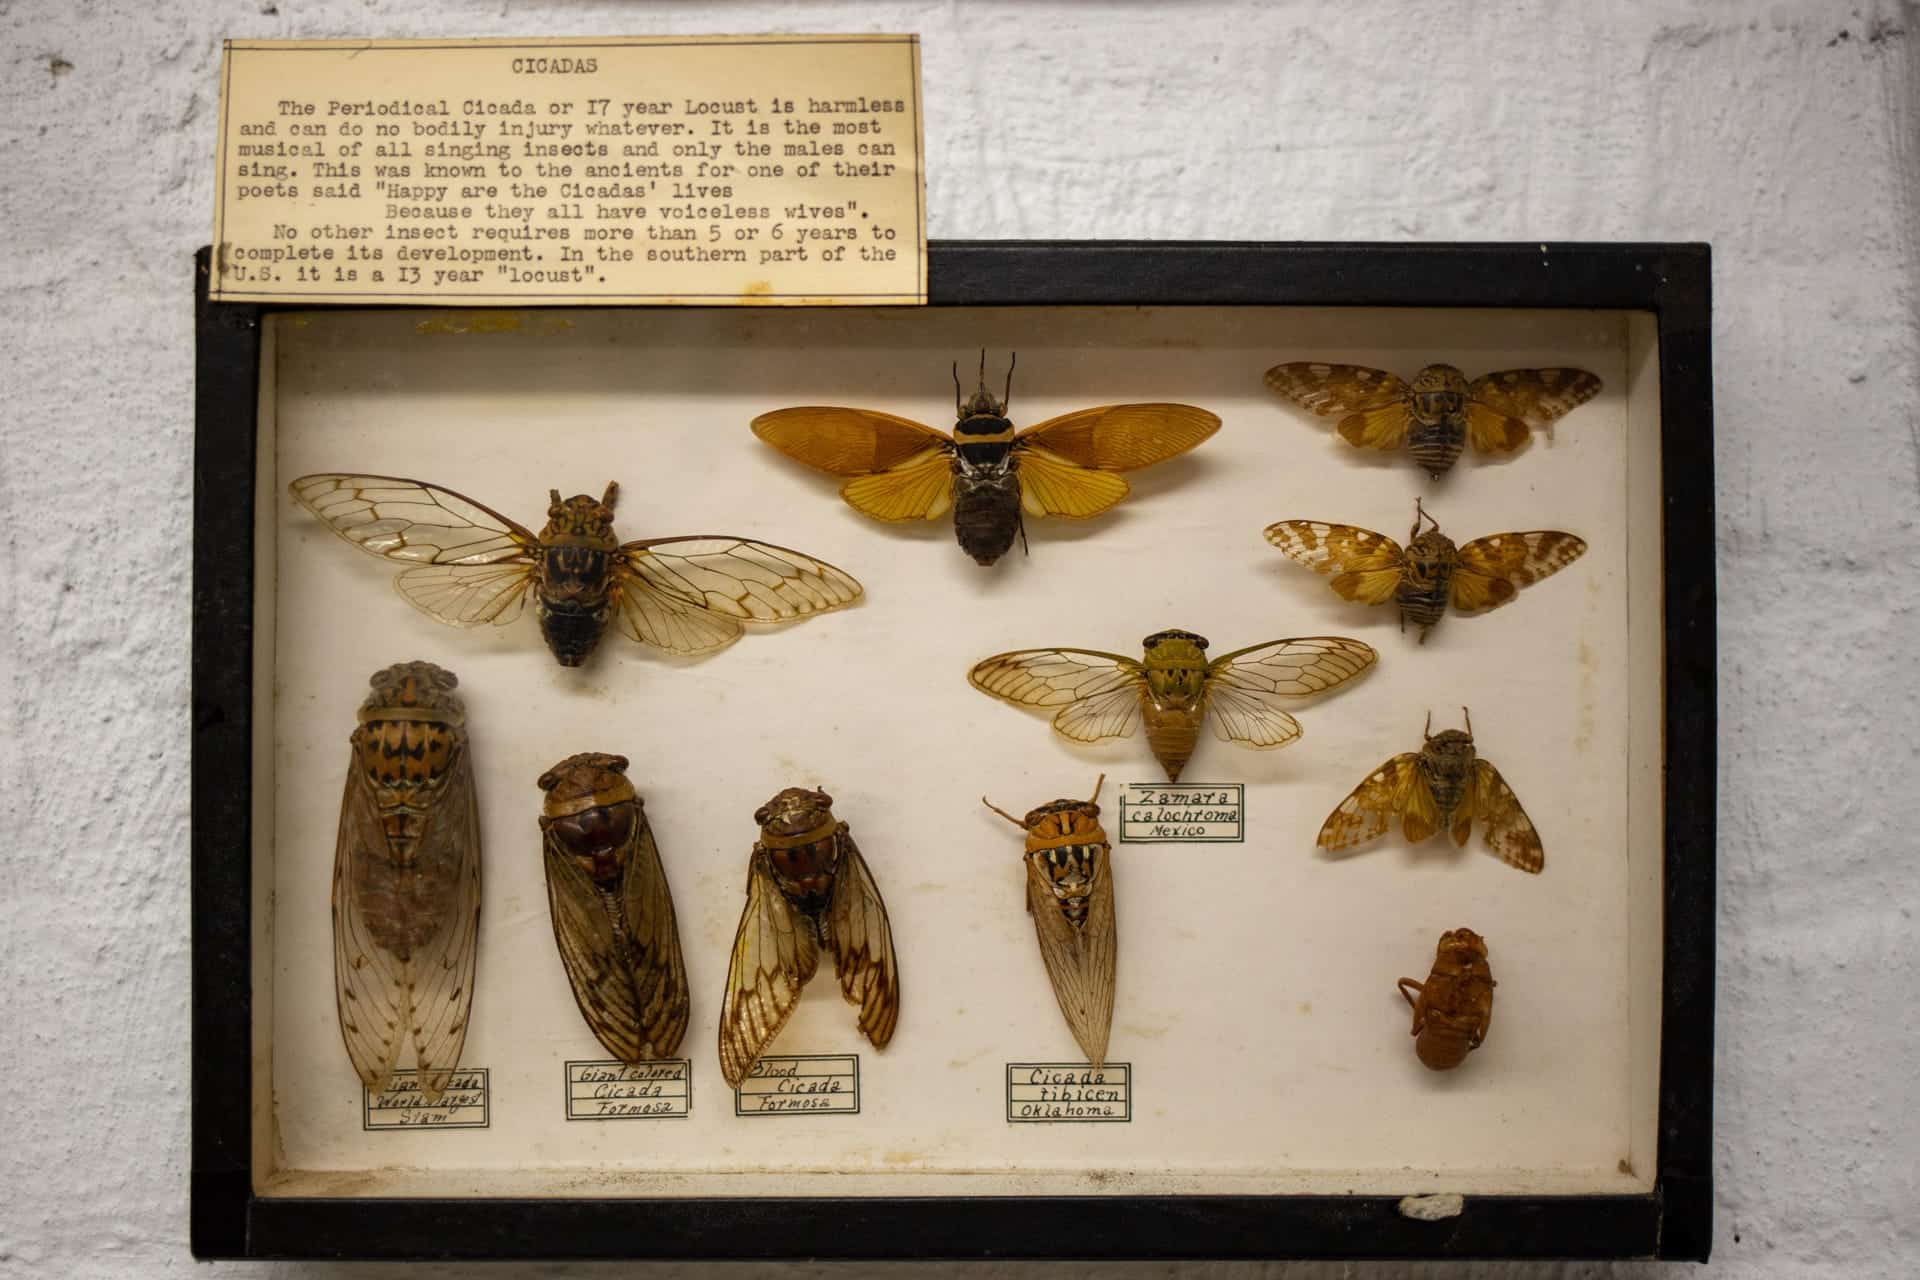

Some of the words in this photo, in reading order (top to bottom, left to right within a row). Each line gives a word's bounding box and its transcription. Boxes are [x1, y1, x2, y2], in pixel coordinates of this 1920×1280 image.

[511, 57, 599, 75] CICADAS
[277, 99, 316, 117] The
[327, 99, 451, 117] Periodical
[462, 98, 537, 116] Cicada
[548, 101, 574, 116] or
[621, 101, 673, 120] year
[684, 97, 759, 116] Locust
[770, 96, 795, 115] is
[807, 96, 905, 114] harmless
[239, 120, 277, 137] and
[289, 123, 328, 137] can
[338, 121, 364, 137] do
[375, 123, 401, 137] no
[412, 120, 487, 141] bodily
[498, 119, 574, 141] injury
[585, 119, 695, 137] whatever.
[711, 119, 734, 137] It
[746, 118, 771, 136] is
[783, 118, 822, 136] the
[831, 118, 882, 136] most
[237, 140, 326, 158] musical
[338, 140, 364, 158] of
[375, 141, 413, 158] all
[424, 141, 512, 158] singing
[523, 140, 609, 158] insects
[622, 140, 660, 158] and
[671, 140, 723, 161] only
[733, 140, 772, 157] the
[783, 139, 845, 157] males
[857, 142, 897, 157] can
[237, 161, 298, 182] sing.
[312, 161, 361, 179] This
[373, 164, 411, 179] was
[423, 161, 487, 179] known
[497, 164, 523, 179] to
[535, 161, 573, 178] the
[584, 161, 684, 179] ancients
[696, 161, 736, 179] for
[746, 164, 785, 179] one
[795, 160, 821, 179] of
[832, 160, 896, 179] their
[236, 181, 299, 201] poets
[312, 182, 363, 199] said
[375, 180, 449, 203] "Happy
[460, 185, 499, 200] are
[509, 182, 548, 199] the
[559, 179, 656, 199] Cicadas'
[671, 182, 734, 199] lives
[384, 203, 473, 220] Because
[484, 202, 535, 224] they
[546, 203, 585, 220] all
[596, 203, 647, 220] have
[658, 203, 771, 220] voiceless
[783, 199, 870, 220] wives".
[272, 223, 299, 240] No
[309, 223, 374, 240] other
[384, 223, 459, 240] insect
[471, 223, 571, 243] requires
[583, 227, 635, 241] more
[647, 224, 697, 241] than
[708, 223, 722, 244] 5
[734, 227, 760, 241] or
[770, 222, 784, 241] 6
[795, 227, 858, 245] years
[871, 223, 897, 241] to
[234, 244, 335, 264] complete
[346, 244, 384, 262] its
[396, 244, 544, 265] development.
[559, 245, 585, 263] In
[595, 245, 635, 263] the
[646, 245, 748, 263] southern
[759, 245, 809, 266] part
[821, 245, 847, 263] of
[858, 245, 897, 262] the
[234, 263, 281, 283] U.S.
[296, 265, 321, 283] it
[333, 265, 358, 283] is
[371, 269, 385, 283] a
[433, 269, 485, 287] year
[497, 263, 607, 284] "locust".
[1139, 790, 1229, 805] Zamara
[1131, 807, 1238, 823] calochroma
[1149, 824, 1206, 837] Mexico
[580, 1065, 627, 1081] Giant
[629, 1063, 685, 1081] colored
[751, 1060, 799, 1077] Blood
[1029, 1067, 1106, 1086] Cicada
[593, 1080, 663, 1099] Cicada
[777, 1076, 841, 1093] Cicada
[1040, 1086, 1119, 1102] tibicen
[597, 1101, 673, 1115] Formosa
[758, 1096, 831, 1111] Formosa
[1020, 1101, 1115, 1118] Oklahoma
